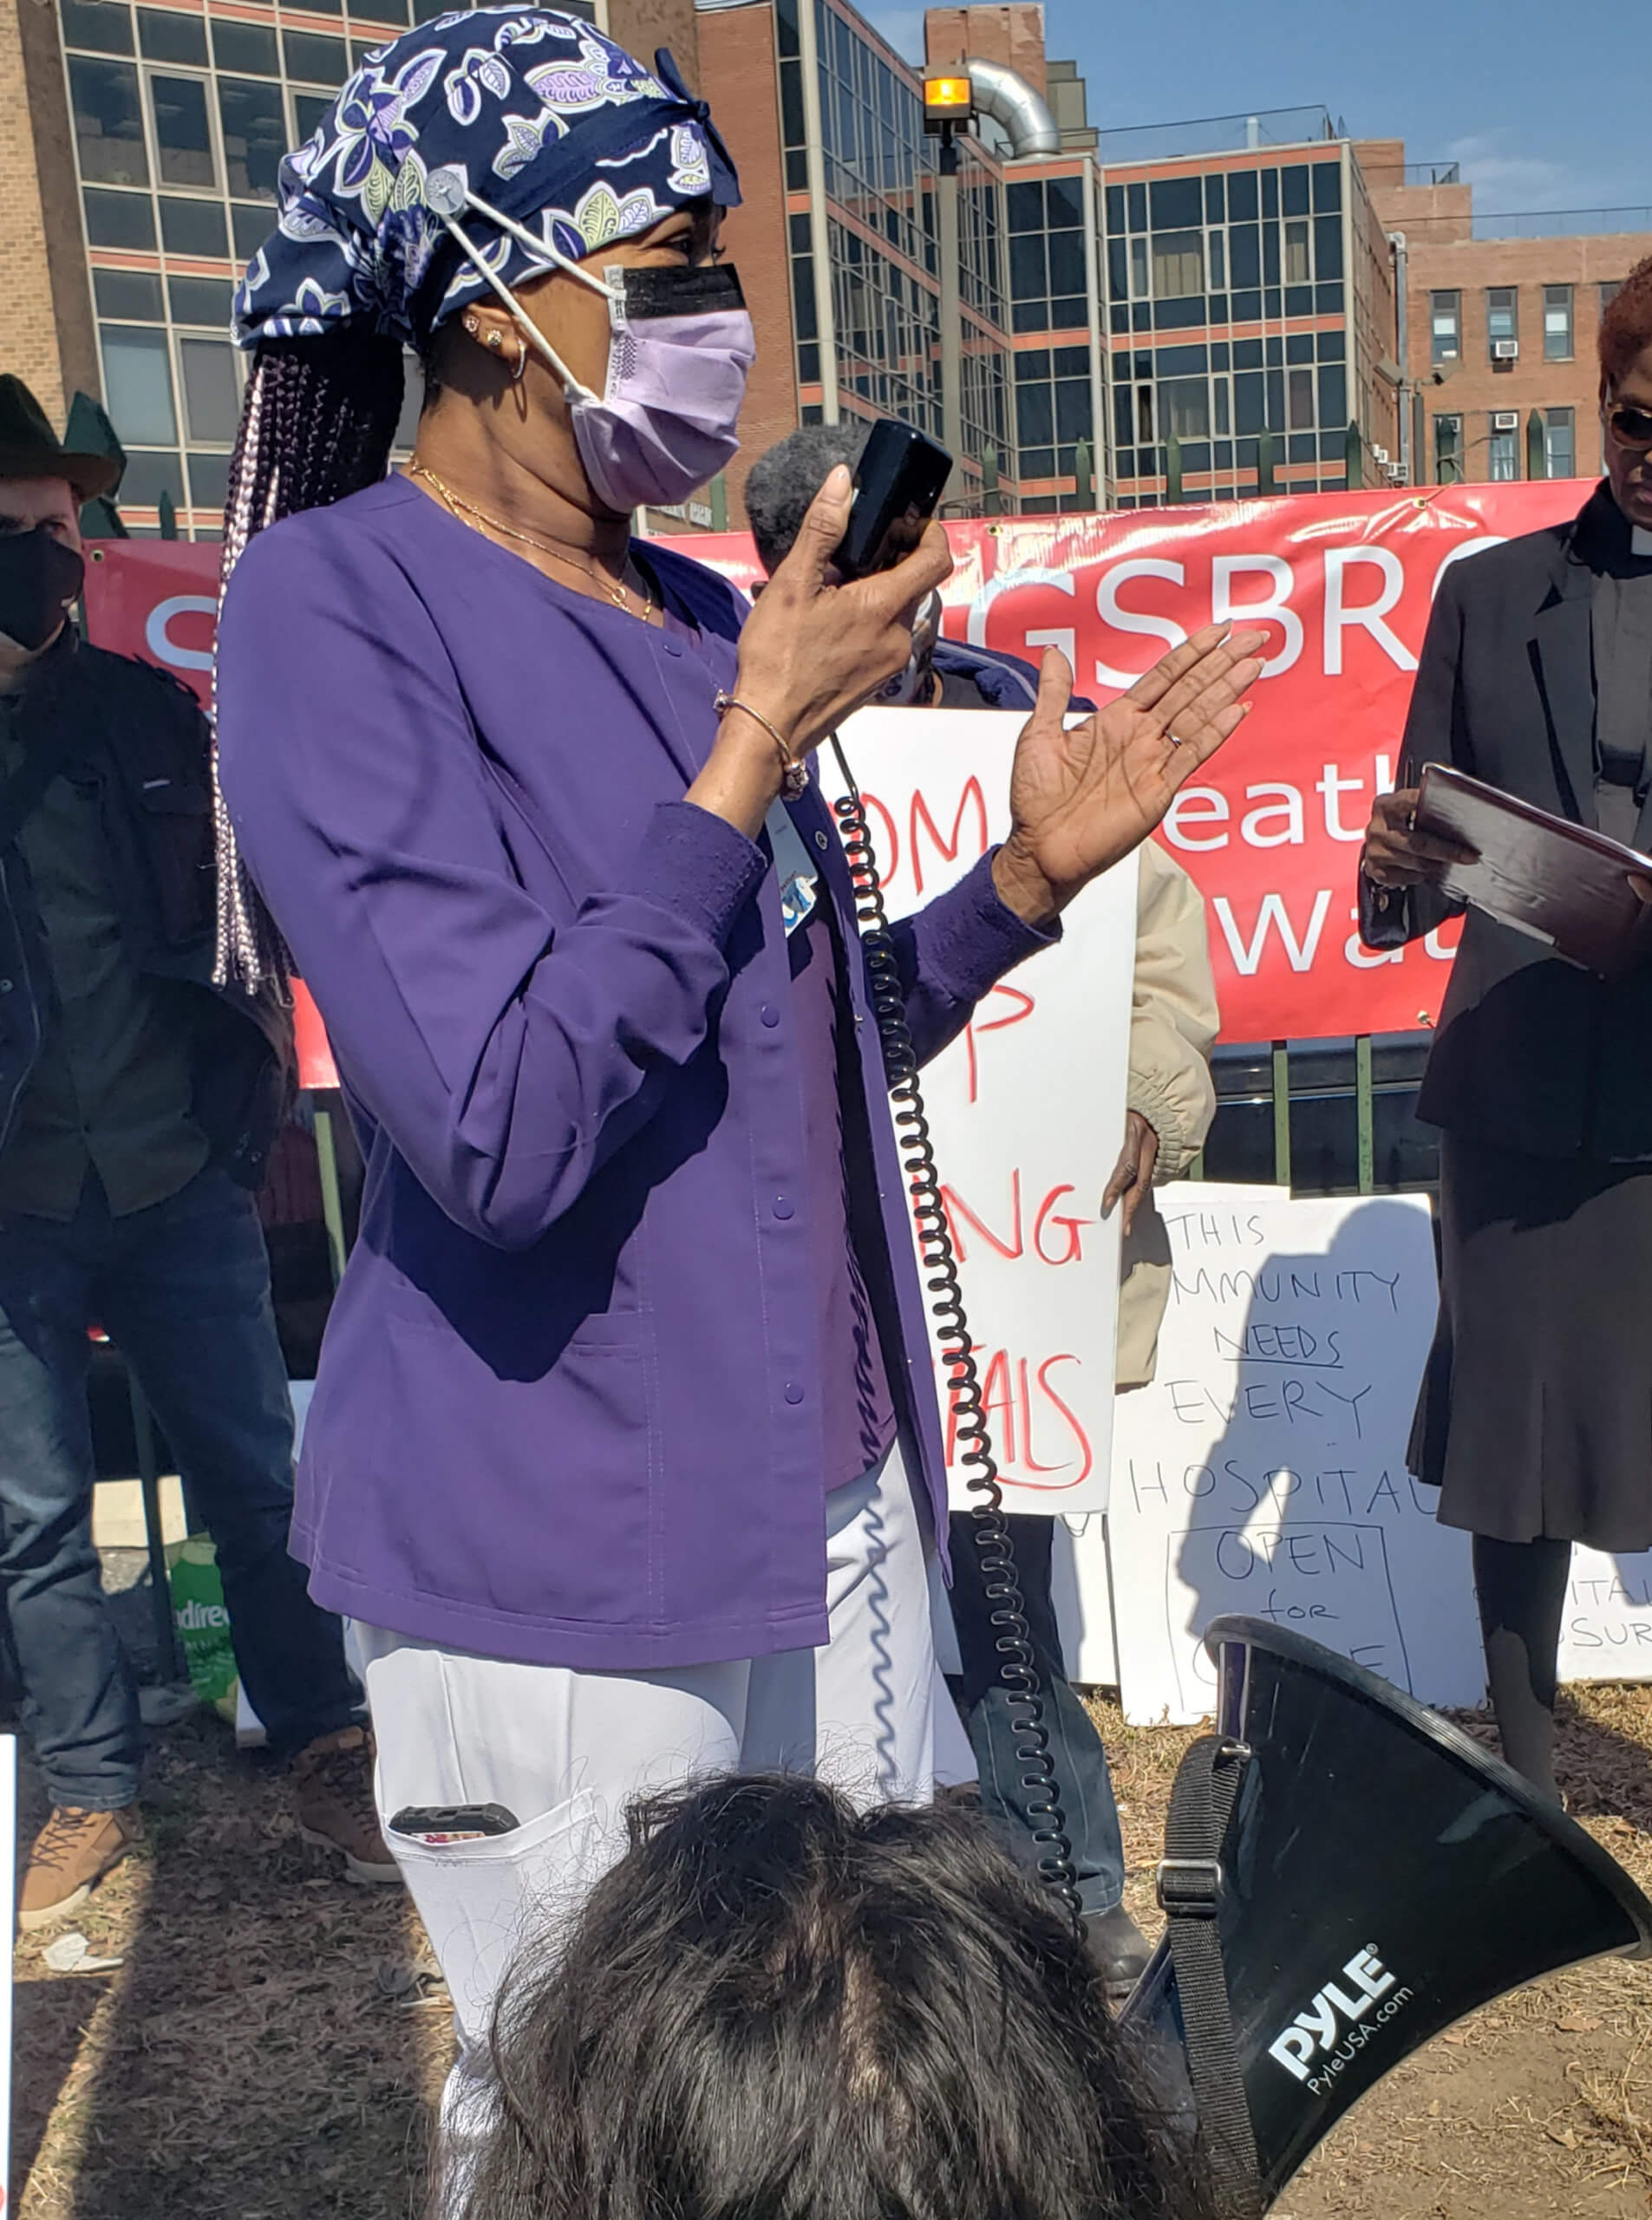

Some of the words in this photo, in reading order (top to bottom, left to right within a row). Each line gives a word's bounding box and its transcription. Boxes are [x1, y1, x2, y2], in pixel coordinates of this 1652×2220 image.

[939, 536, 1510, 689] GSBR
[1163, 754, 1394, 852] eat
[1165, 1213, 1264, 1250] THIS
[1172, 1267, 1401, 1313] MMUNITY
[1214, 1323, 1341, 1366] NEEDS
[940, 1342, 1093, 1489] TALS
[1165, 1379, 1373, 1440] EVERY
[1129, 1459, 1437, 1519] HOSPITAL
[1217, 1530, 1364, 1580] OPEN
[1570, 1575, 1652, 1607] ITAL
[1560, 1617, 1652, 1647] SUR
[1307, 1987, 1414, 2096] PyleUSA.com
